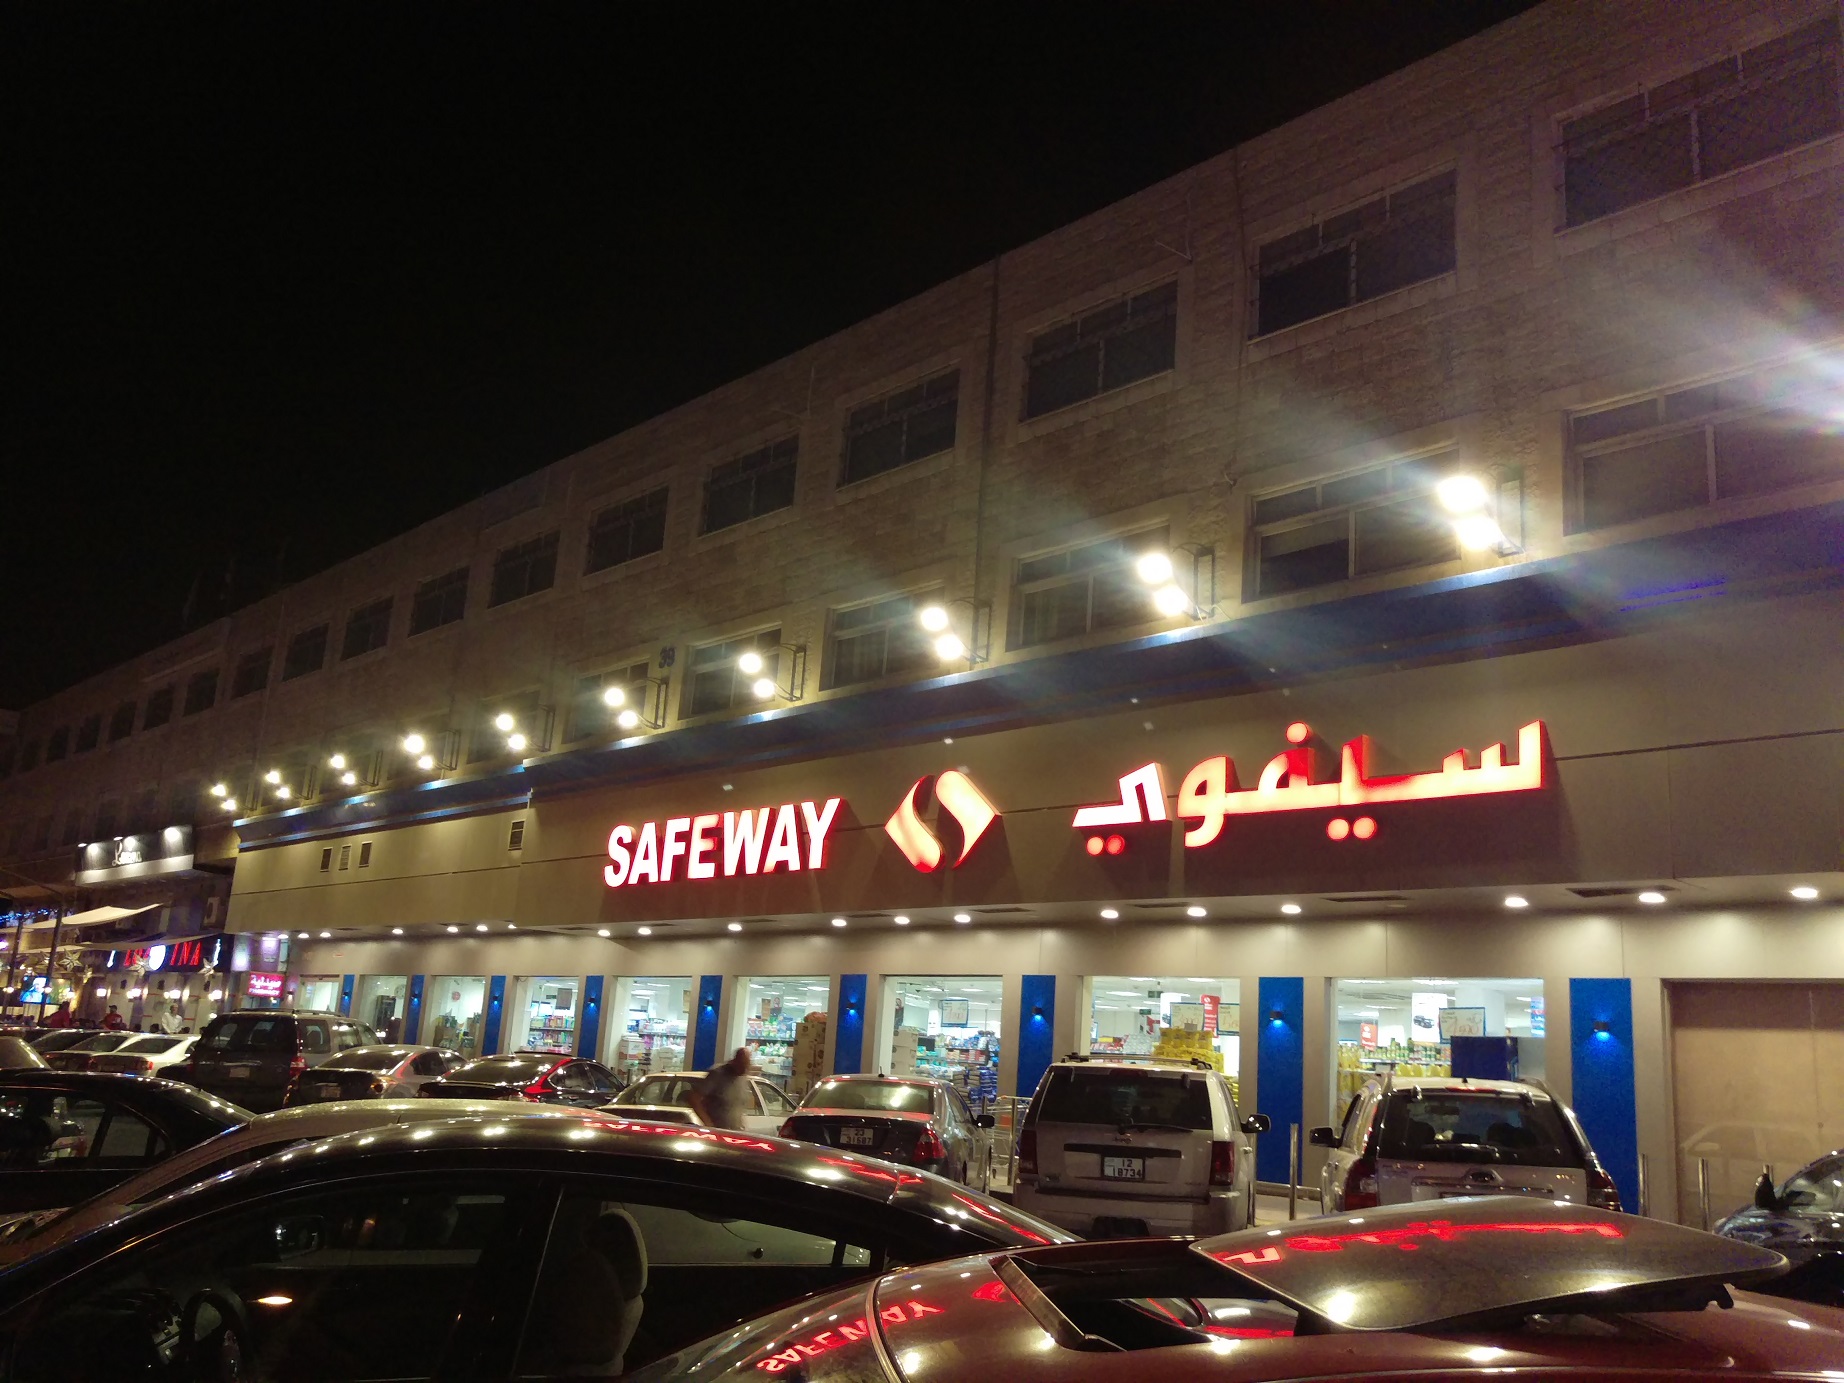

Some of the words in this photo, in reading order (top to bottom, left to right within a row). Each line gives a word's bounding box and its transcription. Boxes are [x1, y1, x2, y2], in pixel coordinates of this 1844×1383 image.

[603, 797, 843, 889] SAFEWAY
[1122, 1159, 1133, 1168] 12
[1113, 1167, 1142, 1177] 18734
